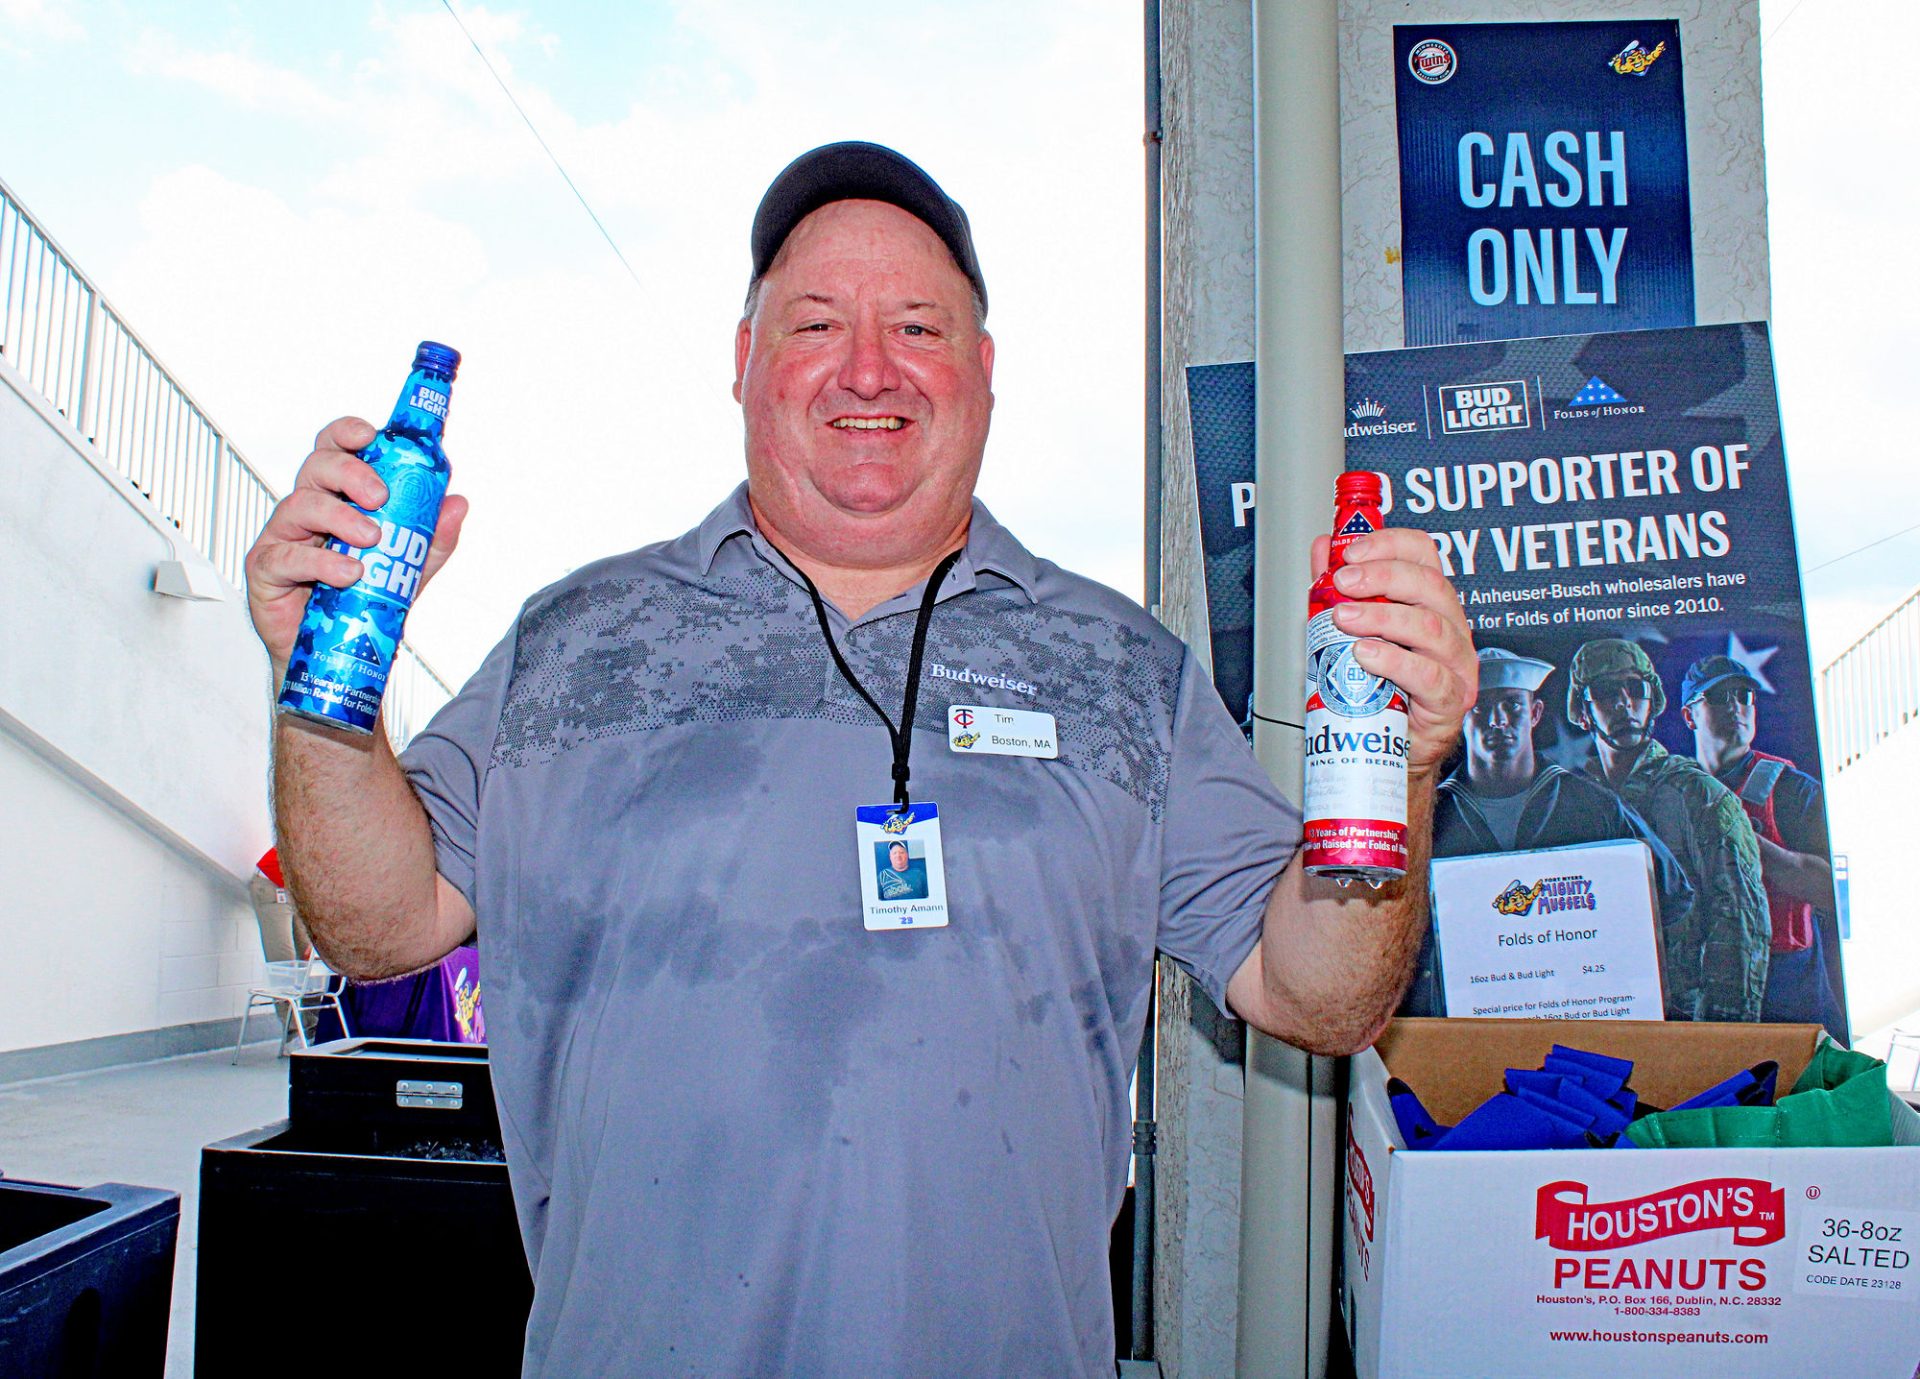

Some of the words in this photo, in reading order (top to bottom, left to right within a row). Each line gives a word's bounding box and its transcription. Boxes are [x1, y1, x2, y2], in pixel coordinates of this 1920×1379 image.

[1413, 53, 1450, 71] Twins
[1457, 131, 1628, 209] CASH
[1467, 228, 1628, 306] ONLY
[418, 386, 446, 405] BUD
[1454, 387, 1510, 409] BUD
[409, 396, 448, 419] LIGHT
[1447, 405, 1523, 428] LIGHT
[1554, 409, 1589, 420] FOLDS
[1603, 406, 1645, 417] HONOR
[1405, 450, 1681, 514] SUPPORTER
[1690, 443, 1750, 491] OF
[374, 519, 428, 567] UD
[1490, 510, 1730, 571] VETERANS
[1469, 581, 1600, 605] Anheuser-Busch
[1605, 577, 1702, 594] wholesalers
[1707, 572, 1746, 587] have
[1478, 614, 1500, 630] for
[1505, 609, 1549, 627] Folds
[1553, 608, 1570, 624] of
[1574, 604, 1623, 622] Honor
[1627, 602, 1670, 618] since
[1674, 597, 1725, 615] 2010.
[930, 663, 1037, 696] Budweiser
[994, 713, 1014, 724] Tim
[991, 735, 1031, 748] Boston,
[1034, 739, 1052, 749] MA
[1338, 826, 1348, 836] of
[1322, 839, 1352, 849] Raised
[1368, 840, 1391, 851] Folds
[1541, 879, 1592, 897] MIGHTY
[870, 905, 907, 915] Timothy
[910, 904, 944, 913] Amann
[1537, 892, 1596, 915] MUSSELS
[1498, 932, 1534, 947] Folds
[1537, 929, 1551, 943] of
[1555, 929, 1598, 941] Honor
[1470, 974, 1488, 984] 16oz
[1490, 973, 1507, 982] Bud
[1508, 972, 1515, 981] &
[1517, 970, 1533, 979] Bud
[1535, 968, 1555, 979] Light
[1582, 964, 1605, 975] $4.25
[1472, 1004, 1501, 1016] Special
[1502, 1003, 1523, 1015] price
[1525, 1002, 1536, 1011] for
[1538, 1000, 1559, 1010] Folds
[1561, 998, 1570, 1007] of
[1572, 997, 1596, 1006] Honor
[1564, 1011, 1580, 1019] Bud
[1592, 1008, 1608, 1017] Bud
[1610, 1006, 1631, 1017] Light
[1567, 1186, 1754, 1241] HOUSTON'S
[1822, 1218, 1903, 1242] 36-8oz
[1808, 1244, 1910, 1269] SALTED
[1554, 1258, 1767, 1291] PEANUTS
[1806, 1274, 1838, 1285] CODE
[1840, 1276, 1868, 1288] DATE
[1536, 1295, 1596, 1306] Houston's,
[1599, 1295, 1621, 1305] P.O.
[1624, 1296, 1646, 1305] Box
[1650, 1296, 1672, 1306] 166,
[1676, 1296, 1717, 1307] Dublin,
[1719, 1296, 1745, 1306] N.C.
[1746, 1296, 1782, 1306] 28332
[1613, 1307, 1701, 1317] 1-800-334-8383
[1549, 1328, 1769, 1345] www.houstonspeanuts.com
